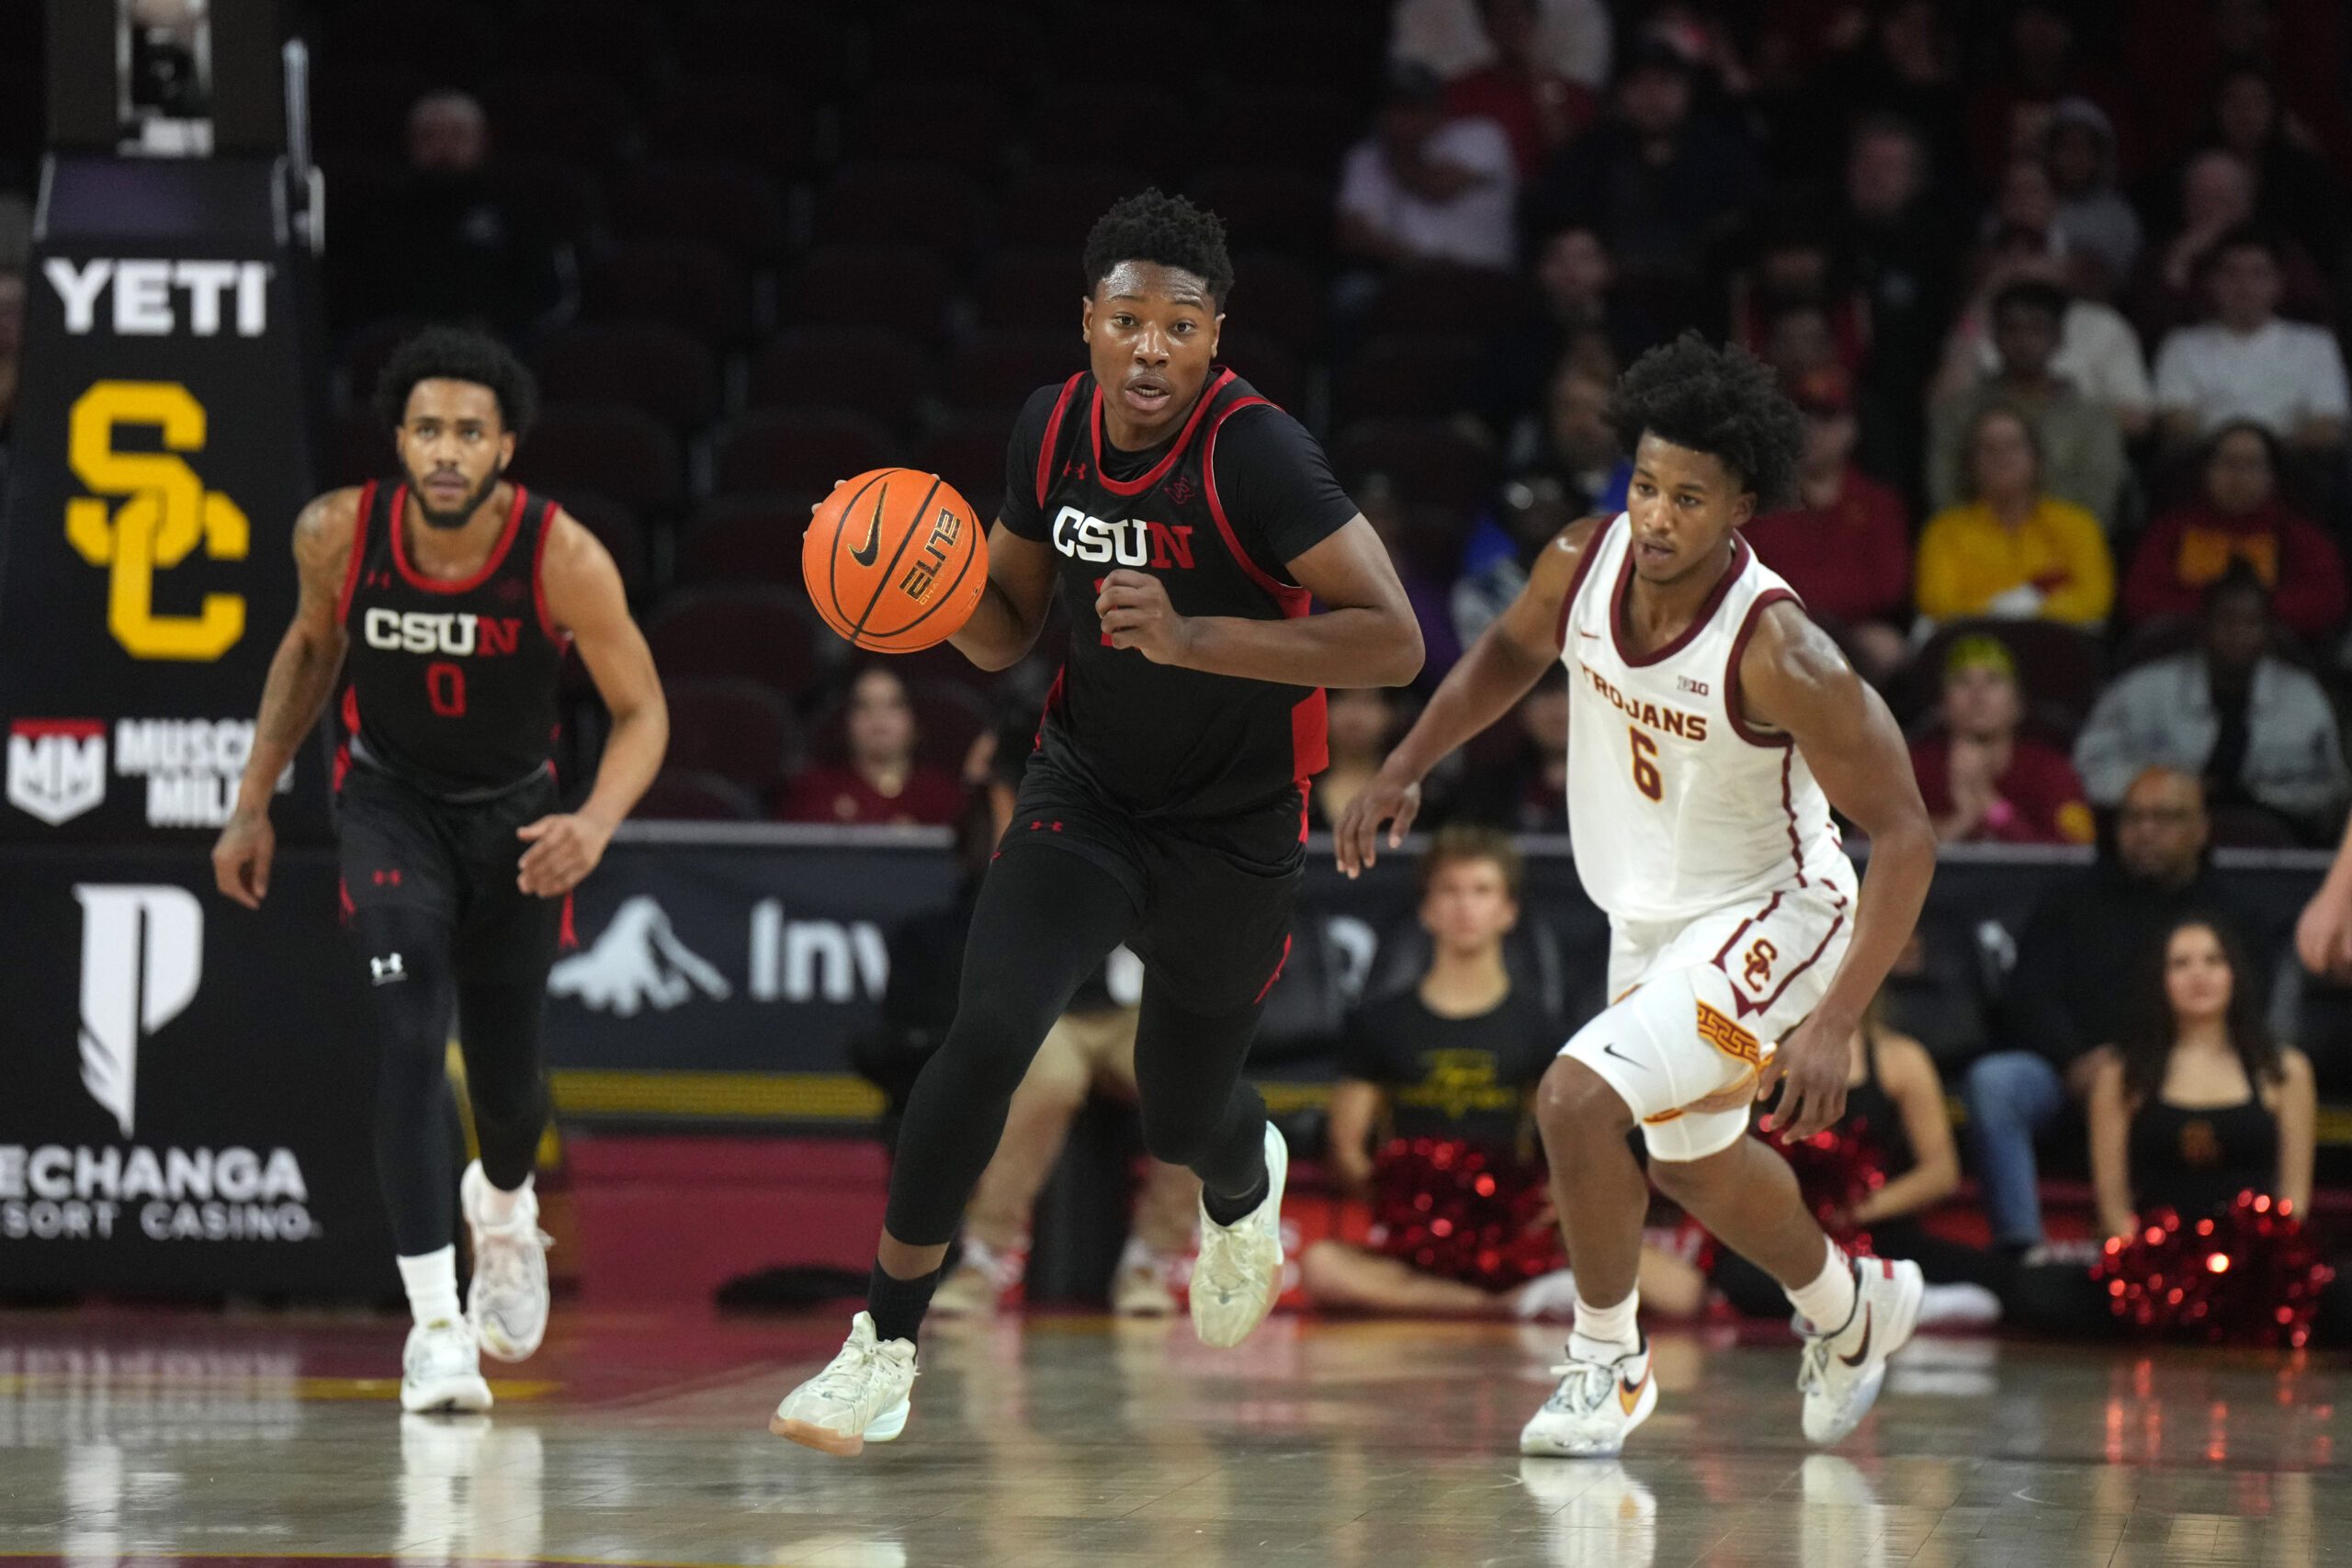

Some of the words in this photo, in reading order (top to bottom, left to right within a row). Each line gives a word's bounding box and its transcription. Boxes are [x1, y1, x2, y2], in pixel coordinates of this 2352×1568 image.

[44, 257, 266, 336] YETI
[899, 507, 962, 602] ELITE
[1053, 505, 1194, 569] CSUN
[365, 607, 522, 657] CSUN
[426, 661, 467, 718] 0
[1580, 661, 1707, 742] TROJANS
[115, 717, 256, 777] MUSC
[1629, 725, 1663, 803] 6
[146, 774, 241, 828] MIL
